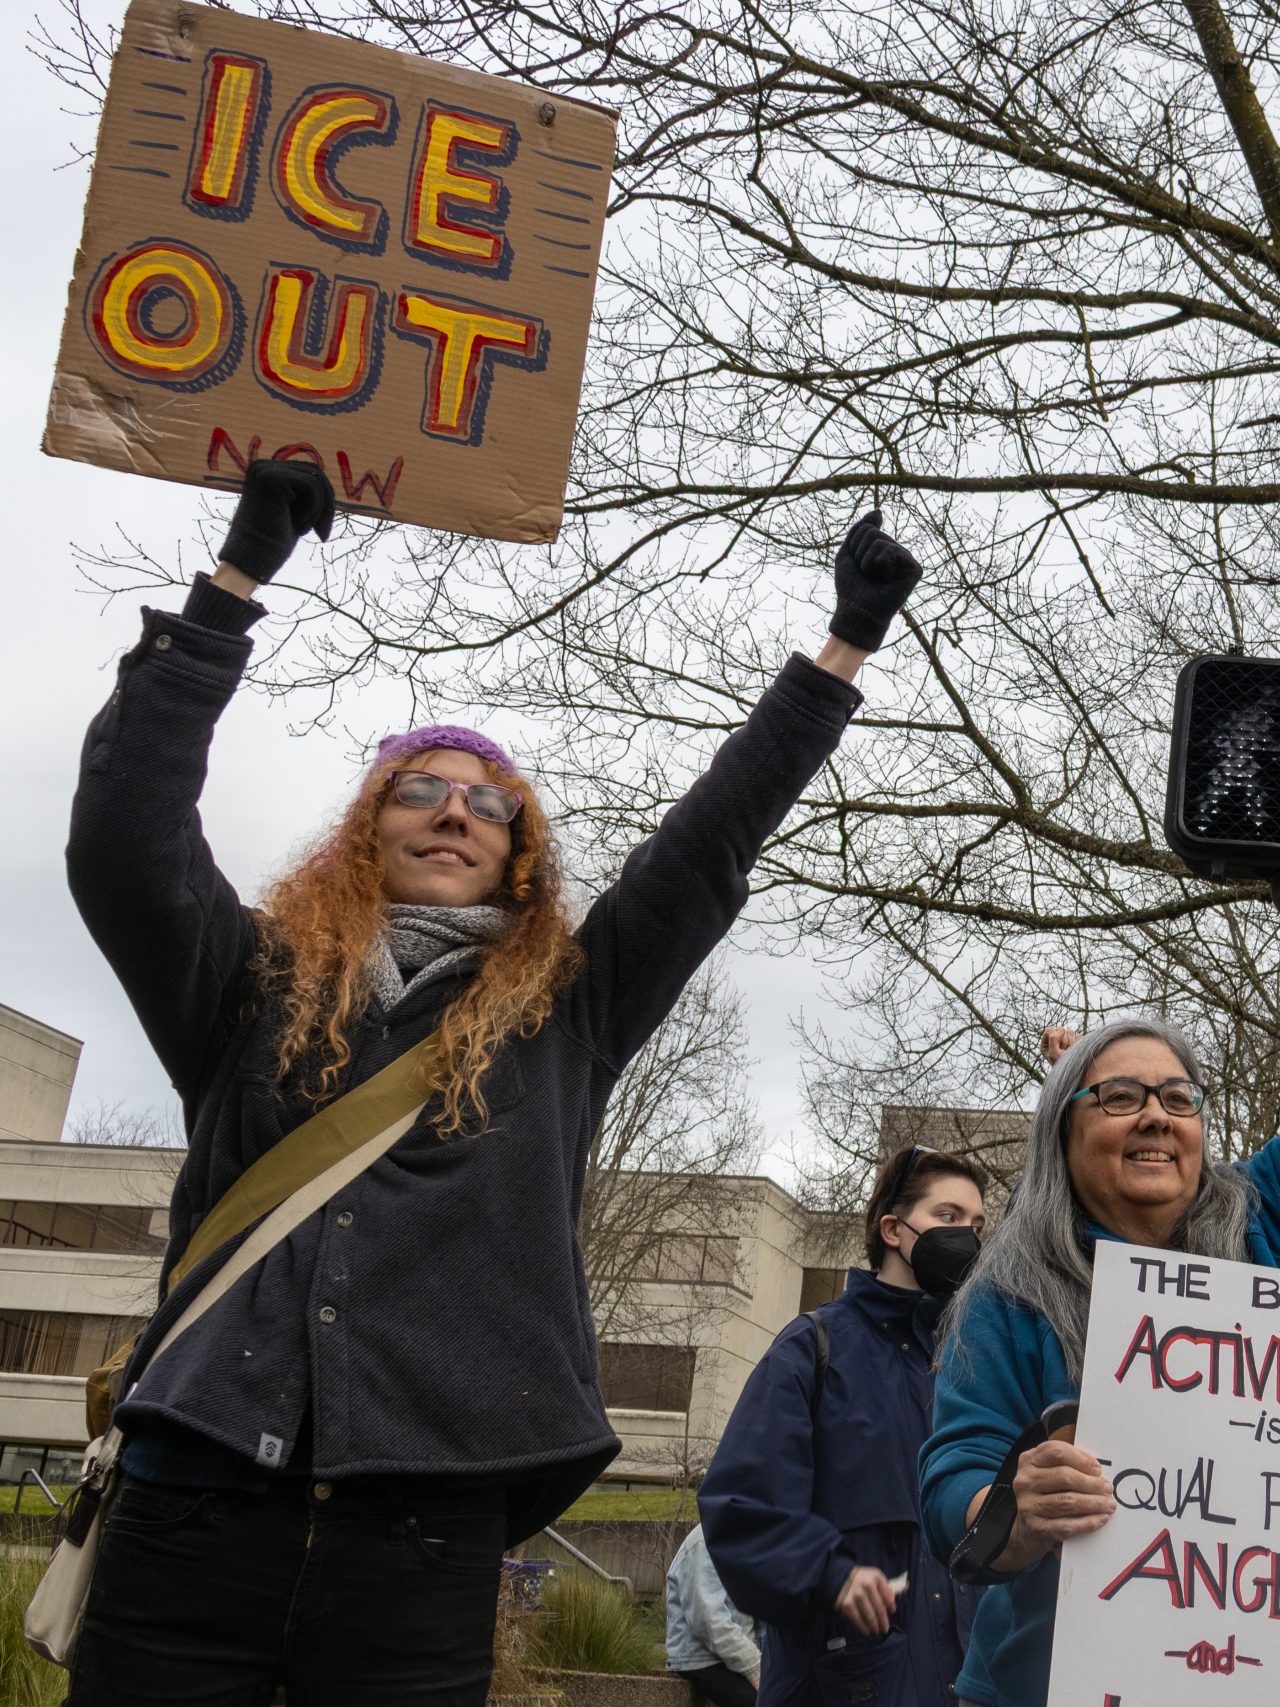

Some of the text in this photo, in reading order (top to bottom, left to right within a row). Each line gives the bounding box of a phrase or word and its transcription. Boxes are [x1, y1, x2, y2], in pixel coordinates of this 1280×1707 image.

[186, 48, 518, 280] ICE
[85, 237, 549, 446] OUT
[1130, 1257, 1210, 1300] THE
[1097, 1457, 1236, 1525] QUAL
